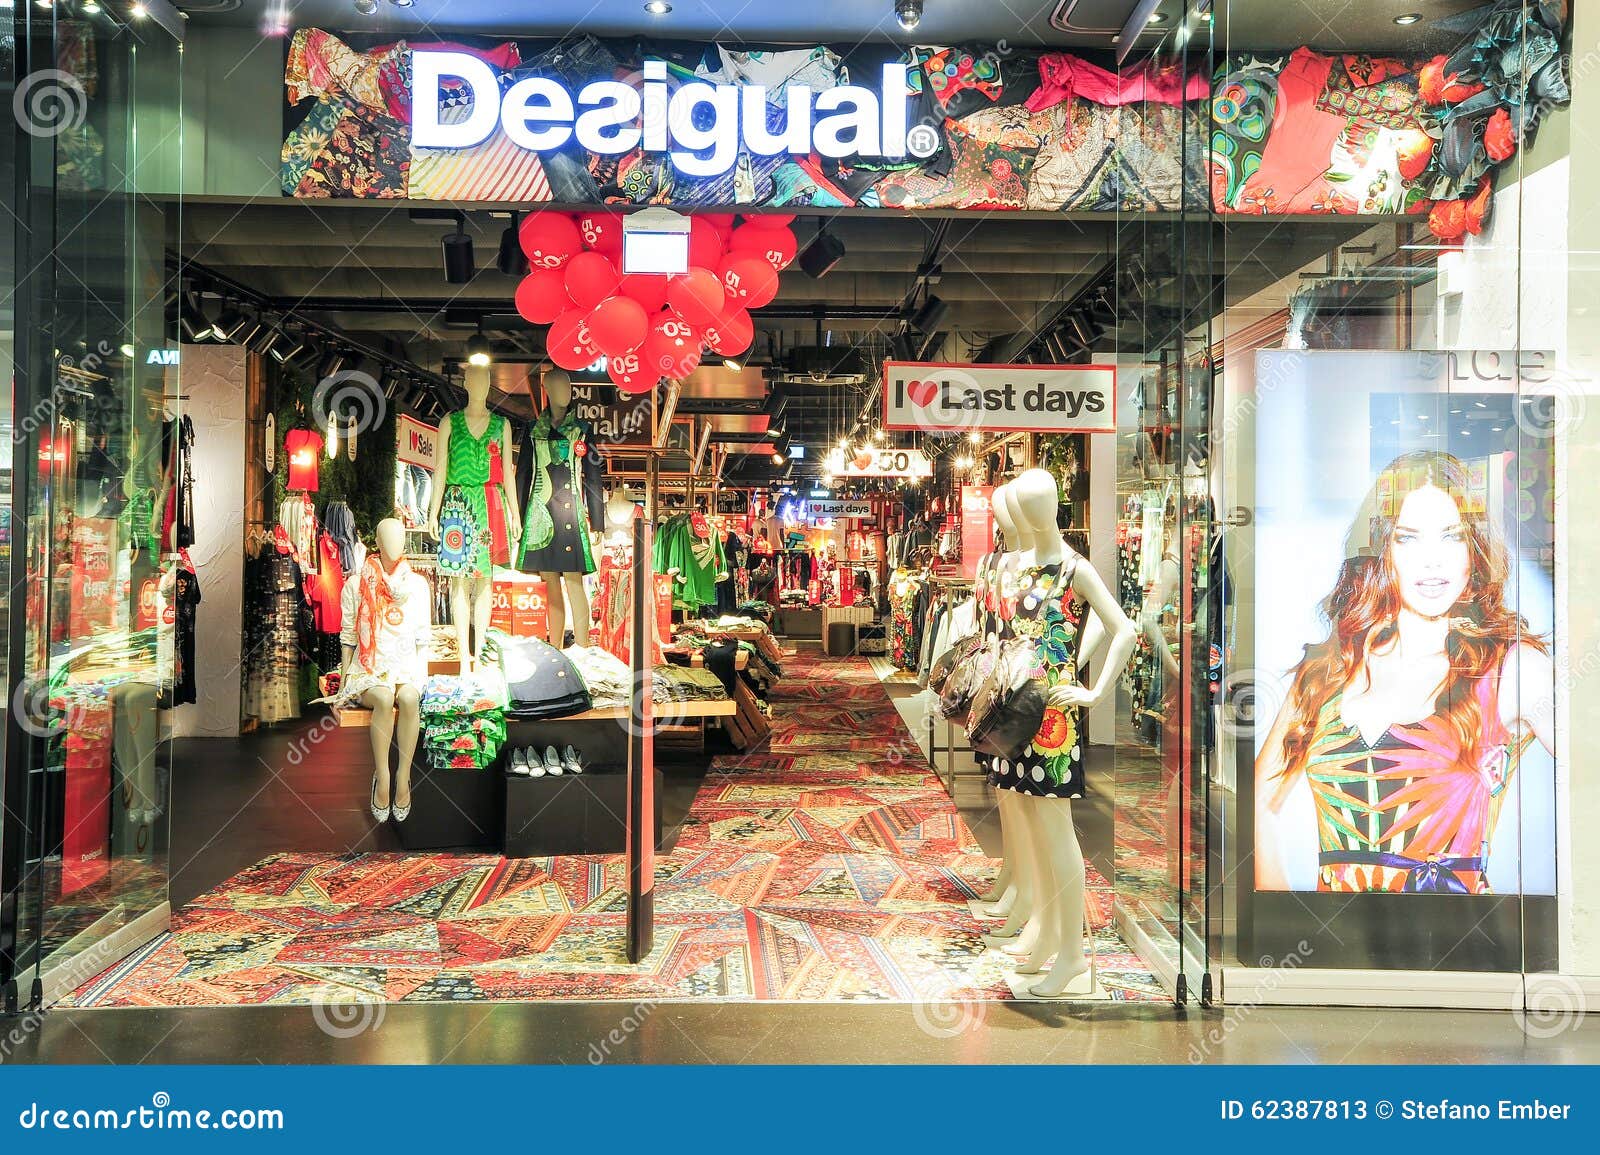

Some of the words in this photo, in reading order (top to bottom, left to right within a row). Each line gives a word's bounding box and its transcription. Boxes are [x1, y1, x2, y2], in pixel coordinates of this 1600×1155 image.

[895, 380, 904, 408] I
[941, 381, 1016, 411] Last
[1023, 383, 1105, 418] days
[418, 434, 432, 457] Sale
[822, 504, 844, 513] Last
[846, 504, 869, 515] days
